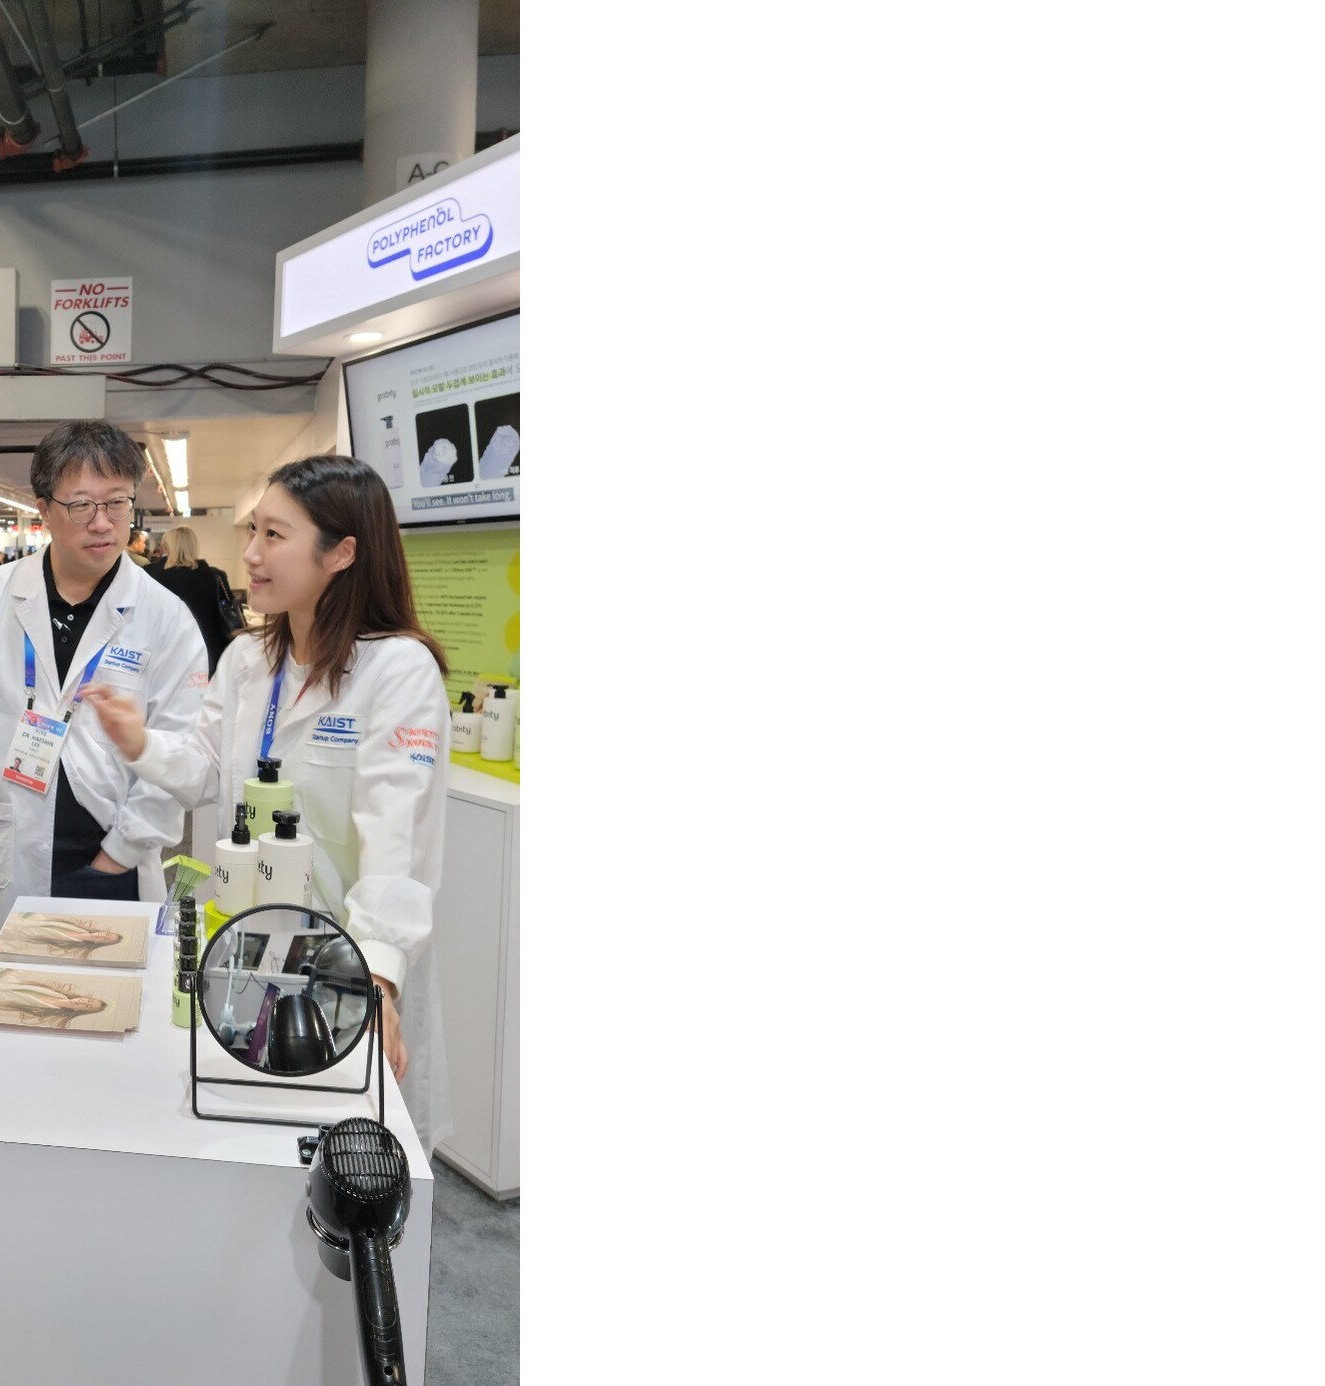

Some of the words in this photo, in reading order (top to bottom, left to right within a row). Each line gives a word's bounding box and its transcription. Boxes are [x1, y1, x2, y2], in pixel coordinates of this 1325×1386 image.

[417, 224, 481, 263] FACTORY
[79, 283, 105, 296] NO
[54, 296, 130, 310] FORKLIFTS
[474, 491, 491, 503] take
[110, 647, 143, 661] KAIST
[265, 703, 276, 735] SONY
[317, 716, 356, 729] KAIST
[330, 735, 359, 745] Company
